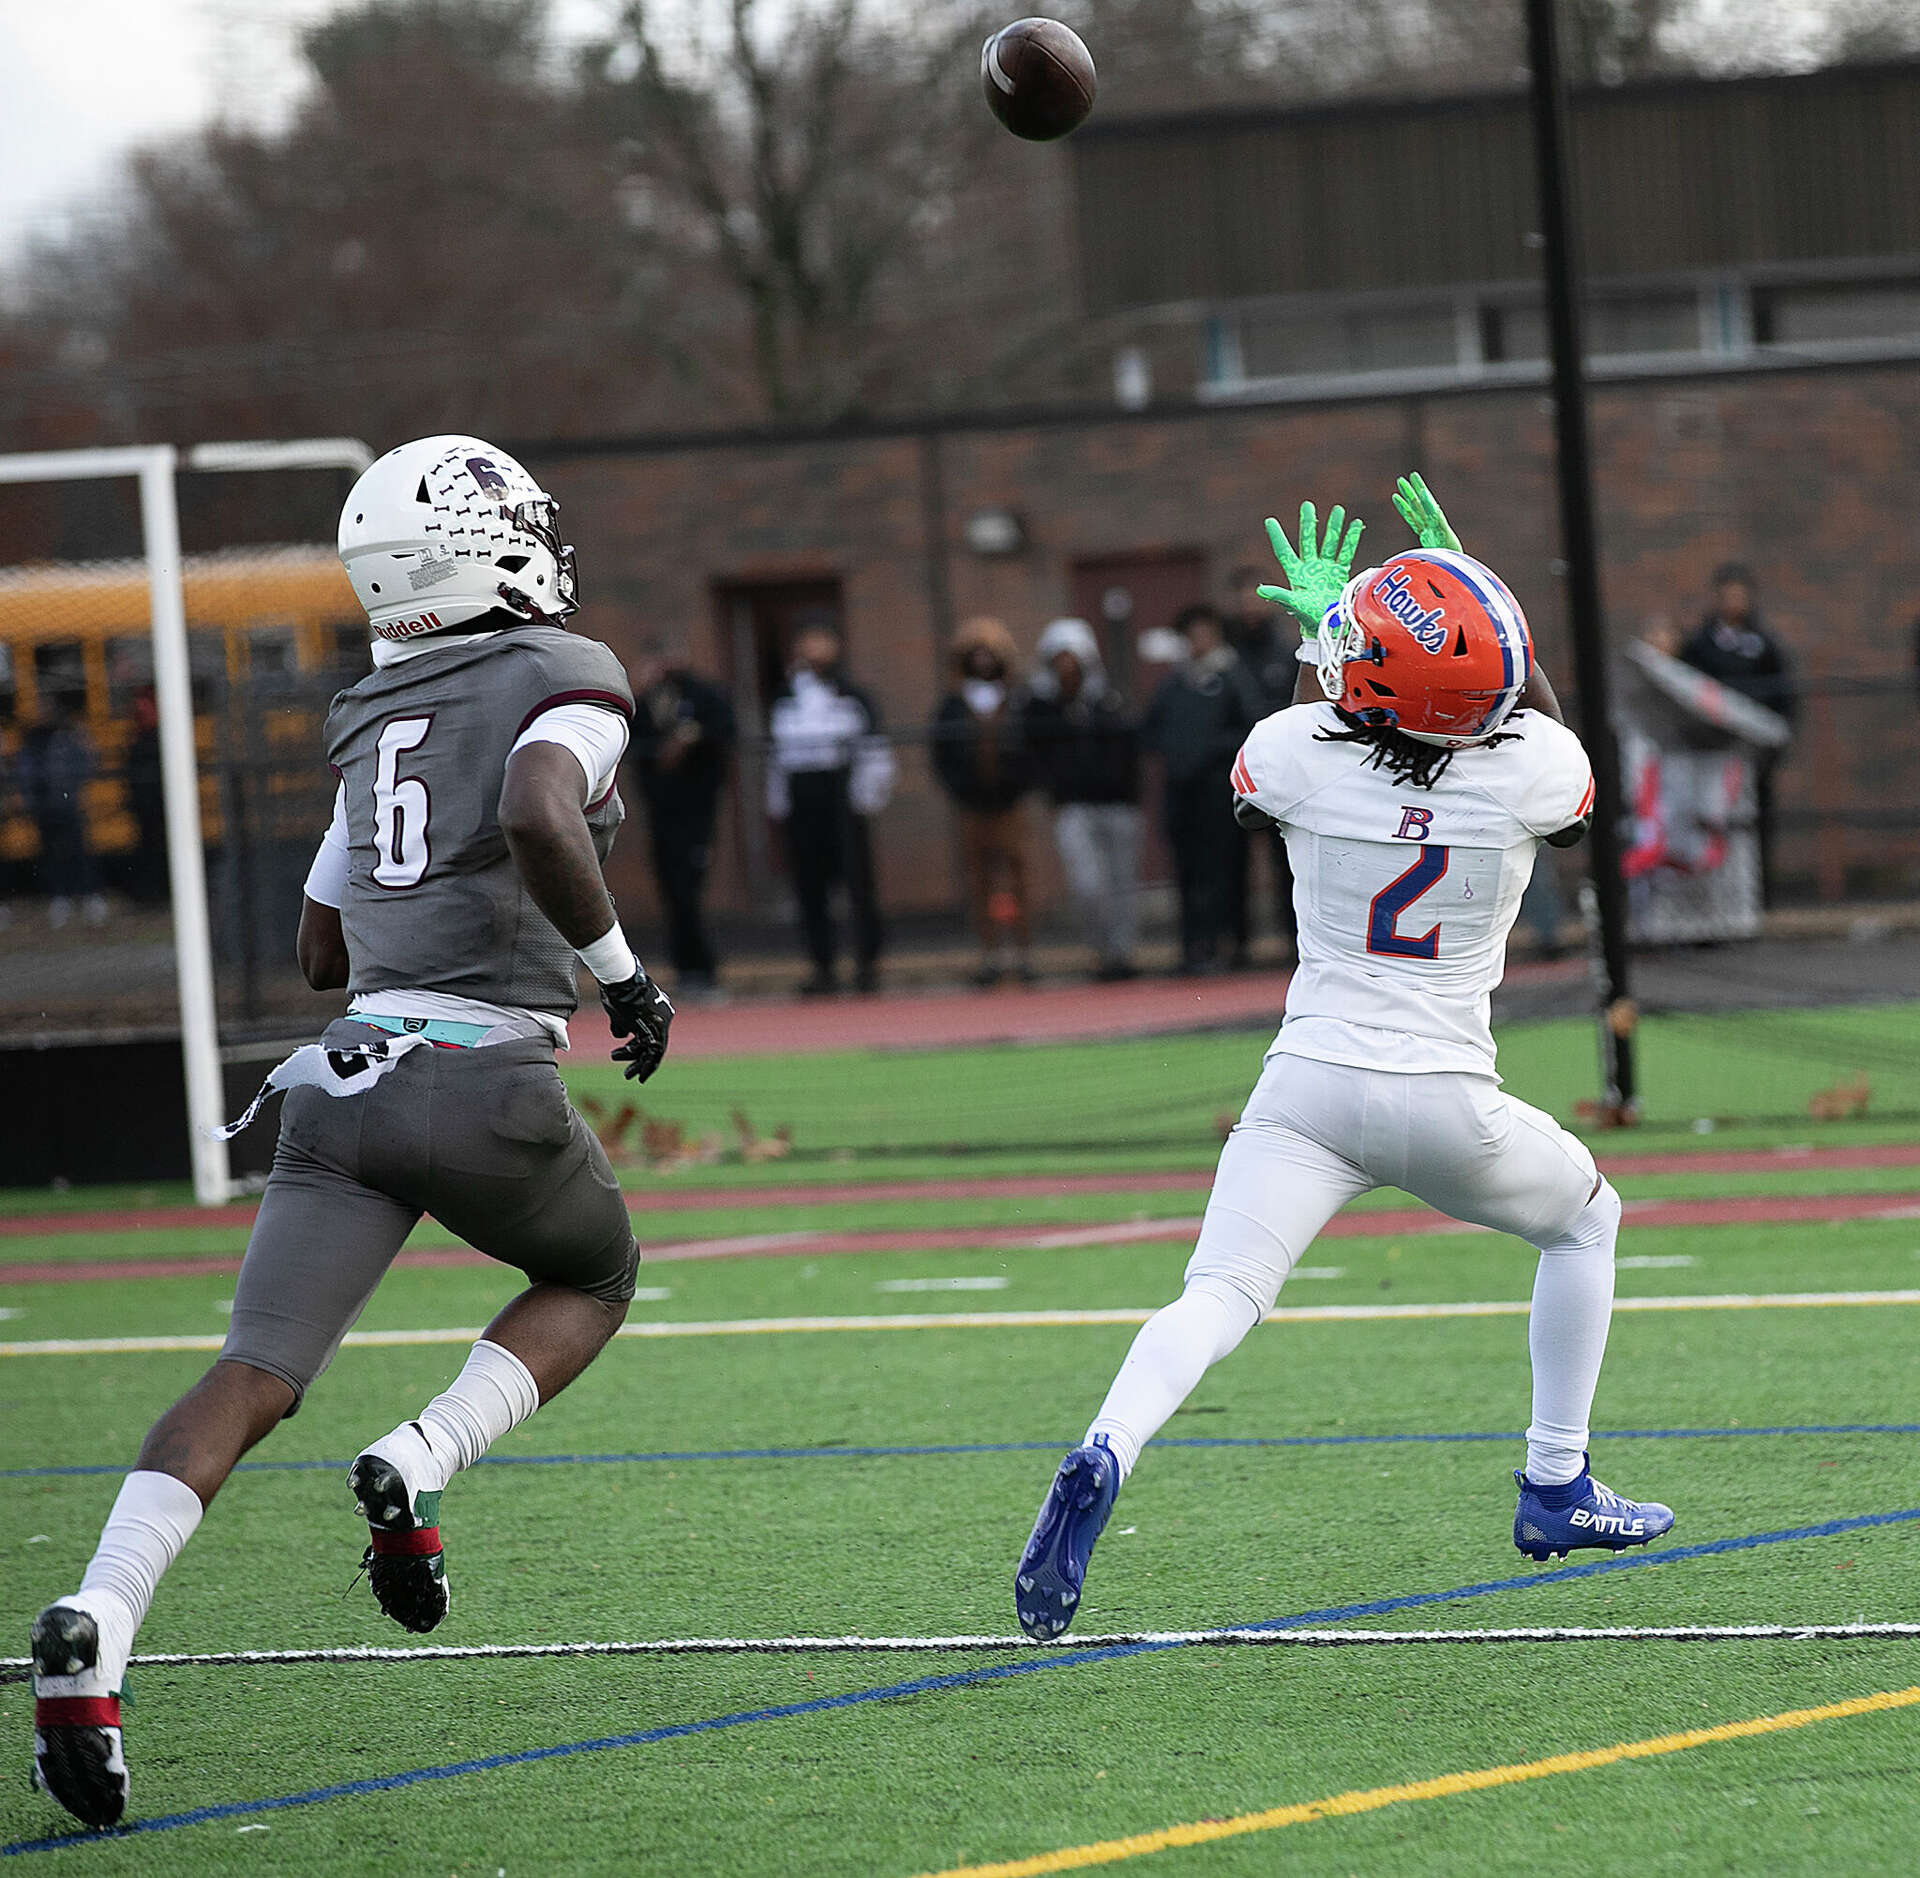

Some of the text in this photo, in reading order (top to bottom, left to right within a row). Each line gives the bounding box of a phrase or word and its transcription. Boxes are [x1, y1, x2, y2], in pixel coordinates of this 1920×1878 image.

[466, 457, 509, 501] 6
[373, 612, 443, 640] Riddell
[1373, 565, 1448, 654] Hawks
[371, 712, 435, 891] 6
[1391, 805, 1435, 841] B
[1366, 844, 1450, 960] 2
[1569, 1508, 1646, 1536] BATTLE
